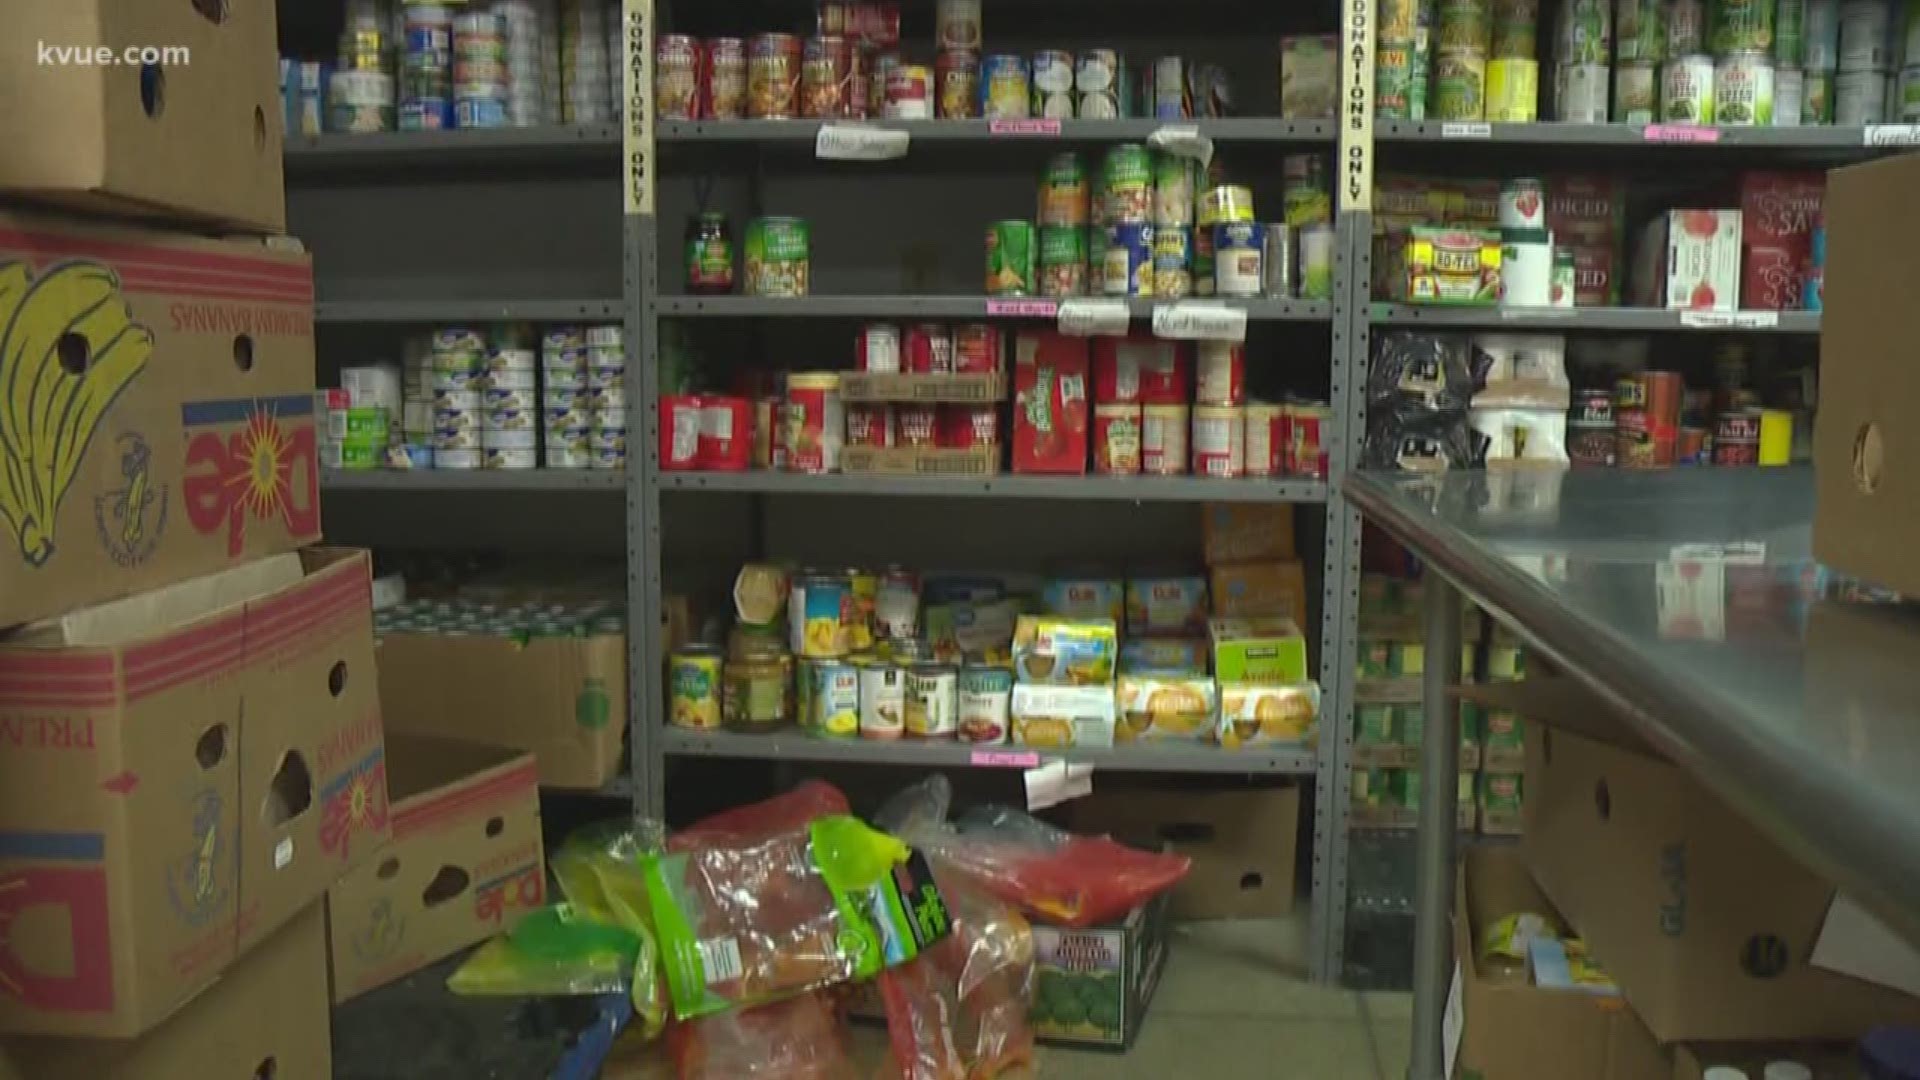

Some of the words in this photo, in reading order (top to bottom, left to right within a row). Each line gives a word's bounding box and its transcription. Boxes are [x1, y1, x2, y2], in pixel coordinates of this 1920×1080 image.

[630, 11, 643, 138] DONATIONS
[1350, 0, 1366, 130] DONATIONS
[631, 151, 644, 206] ONLY
[1349, 145, 1363, 201] ONLY
